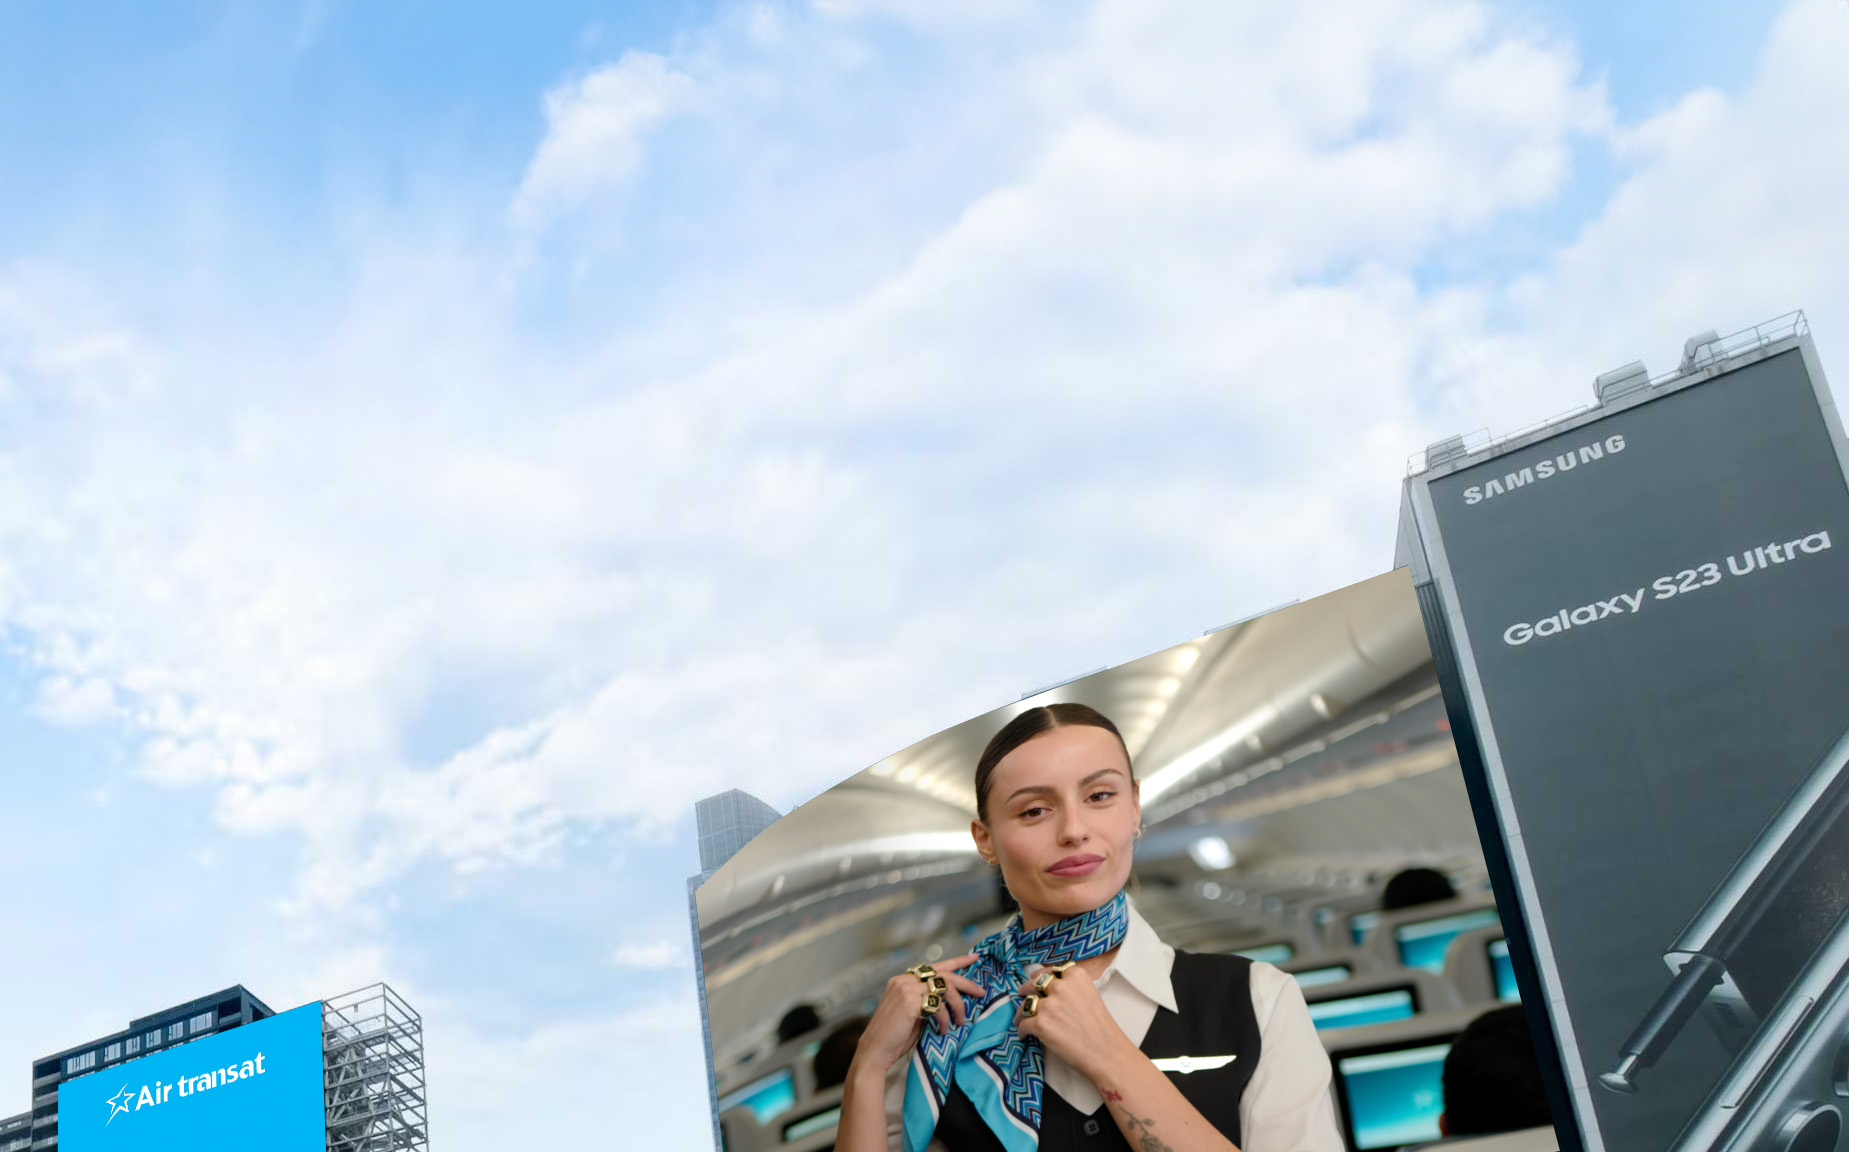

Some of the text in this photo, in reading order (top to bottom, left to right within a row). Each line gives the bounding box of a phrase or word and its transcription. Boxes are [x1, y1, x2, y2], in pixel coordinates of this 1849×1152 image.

[1464, 434, 1625, 504] SAMSUNG
[1503, 530, 1831, 646] Galaxy S23 Ultra
[135, 1052, 265, 1111] Air transat
